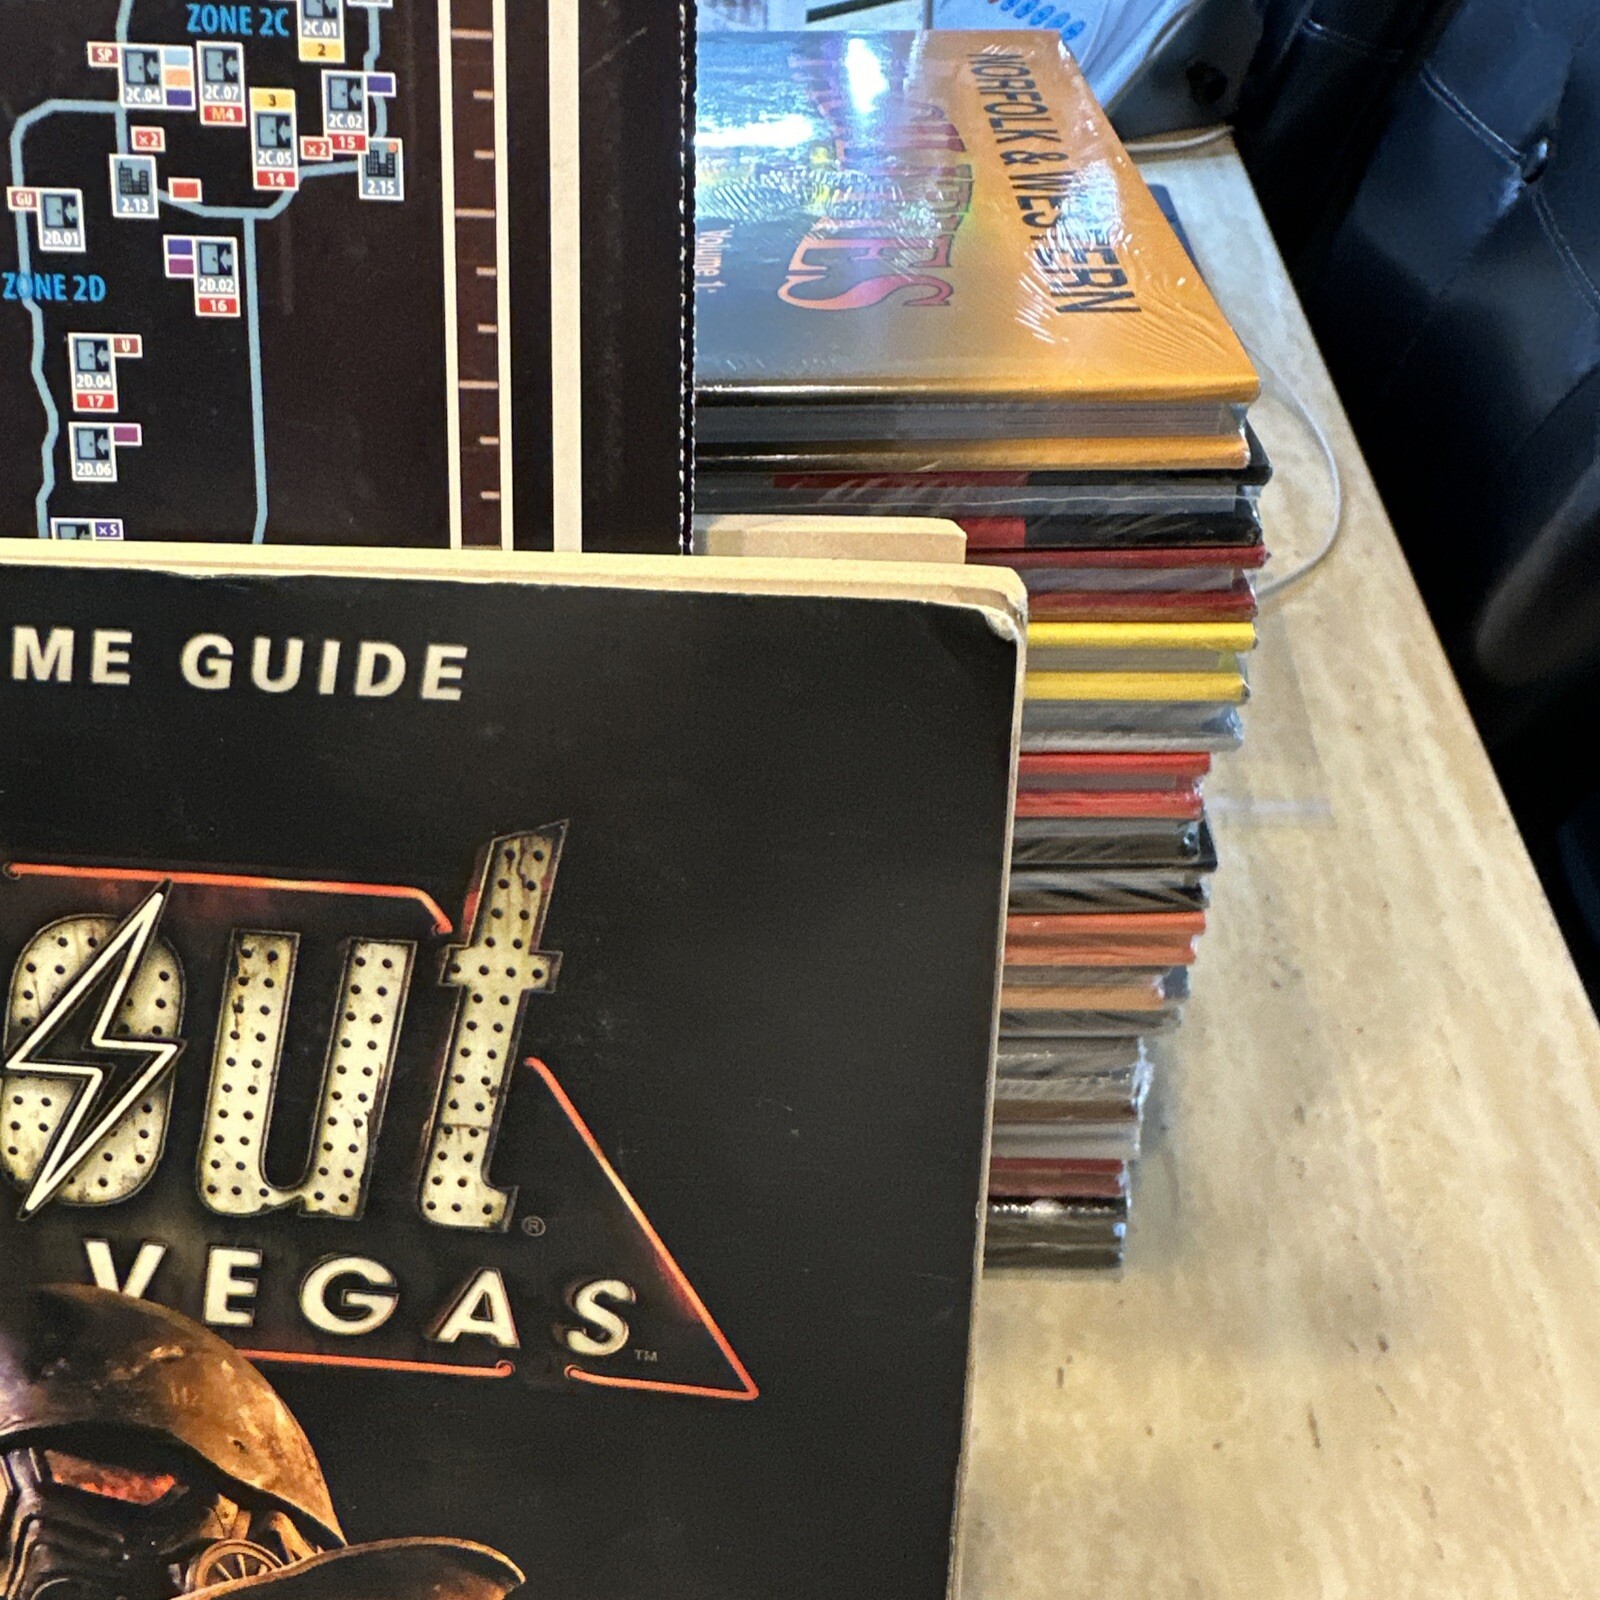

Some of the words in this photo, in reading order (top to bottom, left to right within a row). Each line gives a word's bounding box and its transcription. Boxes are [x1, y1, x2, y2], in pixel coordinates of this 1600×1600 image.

[186, 4, 253, 36] ZONE
[259, 7, 290, 37] 2C
[303, 21, 338, 37] 2C.01
[96, 48, 113, 62] SP
[317, 43, 327, 57] 2
[126, 87, 161, 103] 2C.04
[204, 85, 239, 100] 2C.07
[967, 53, 1062, 145] NORFOLK
[268, 94, 277, 107] 3
[211, 109, 236, 121] M4
[328, 113, 364, 129] 2C.02
[338, 136, 356, 149] 15
[258, 151, 292, 165] 2C.05
[999, 149, 1070, 167] &
[267, 172, 286, 186] 14
[367, 180, 395, 195] 2.15
[16, 192, 33, 206] GU
[122, 198, 149, 212] 2.13
[44, 230, 79, 246] 2D.01
[695, 229, 733, 277] Volume
[2, 272, 67, 301] ZONE
[73, 274, 107, 302] 2D
[199, 278, 235, 293] 2D.02
[209, 300, 228, 312] 16
[121, 338, 131, 353] U
[76, 373, 112, 388] 2D.04
[88, 395, 105, 408] 17
[76, 462, 112, 477] 2D.06
[11, 626, 134, 686] ME
[180, 632, 470, 702] GUIDE
[81, 1239, 638, 1357] VEGAS
